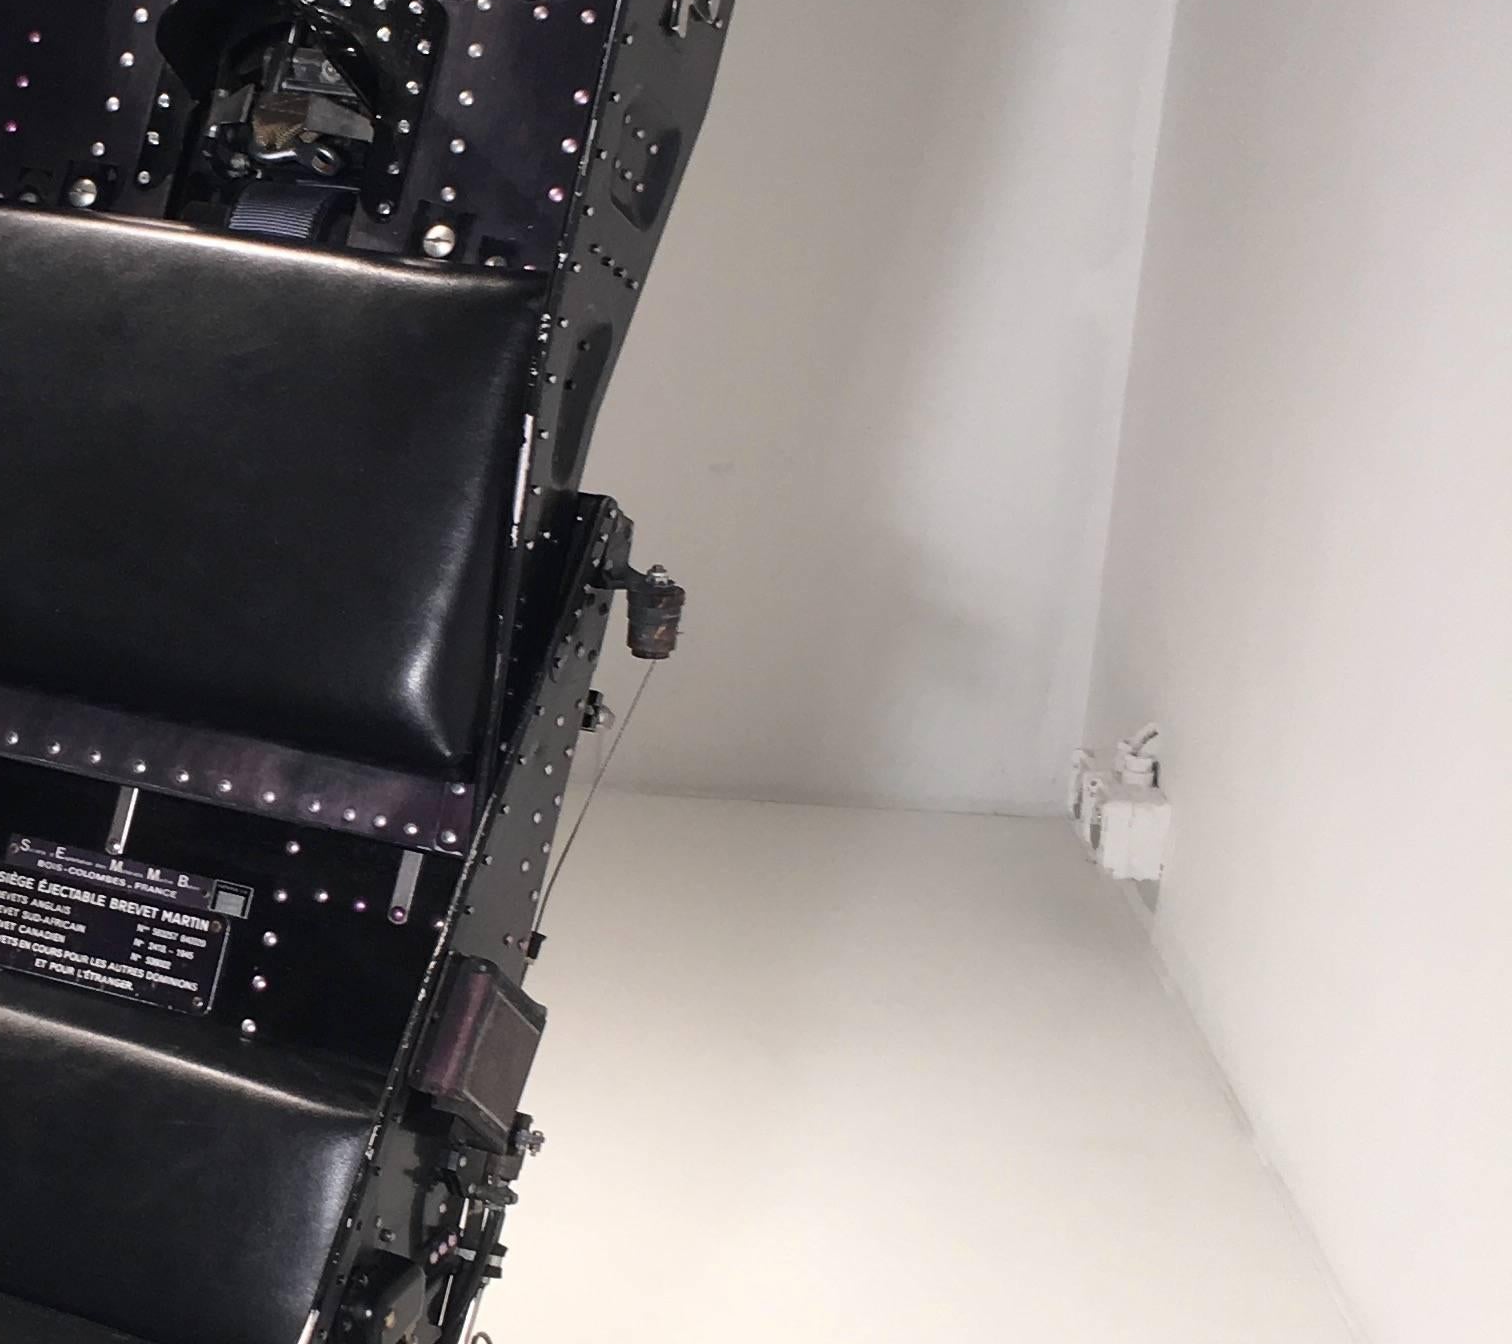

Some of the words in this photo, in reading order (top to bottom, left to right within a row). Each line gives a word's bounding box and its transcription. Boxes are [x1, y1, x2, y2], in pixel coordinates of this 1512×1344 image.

[134, 882, 177, 899] FRANCE
[30, 898, 71, 915] ANGLAIS
[37, 878, 107, 908] ÉJECTABLE
[109, 897, 160, 919] BREVET
[161, 909, 210, 932] MARTIN
[18, 924, 66, 944] CANADIEN
[18, 939, 32, 950] EN
[31, 942, 63, 958] COURS
[63, 950, 89, 965] POUR
[89, 956, 107, 969] LES
[107, 962, 145, 978] AUTRES
[146, 971, 199, 992] DOMINIONS
[34, 958, 48, 968] ET
[49, 962, 76, 976] POUR
